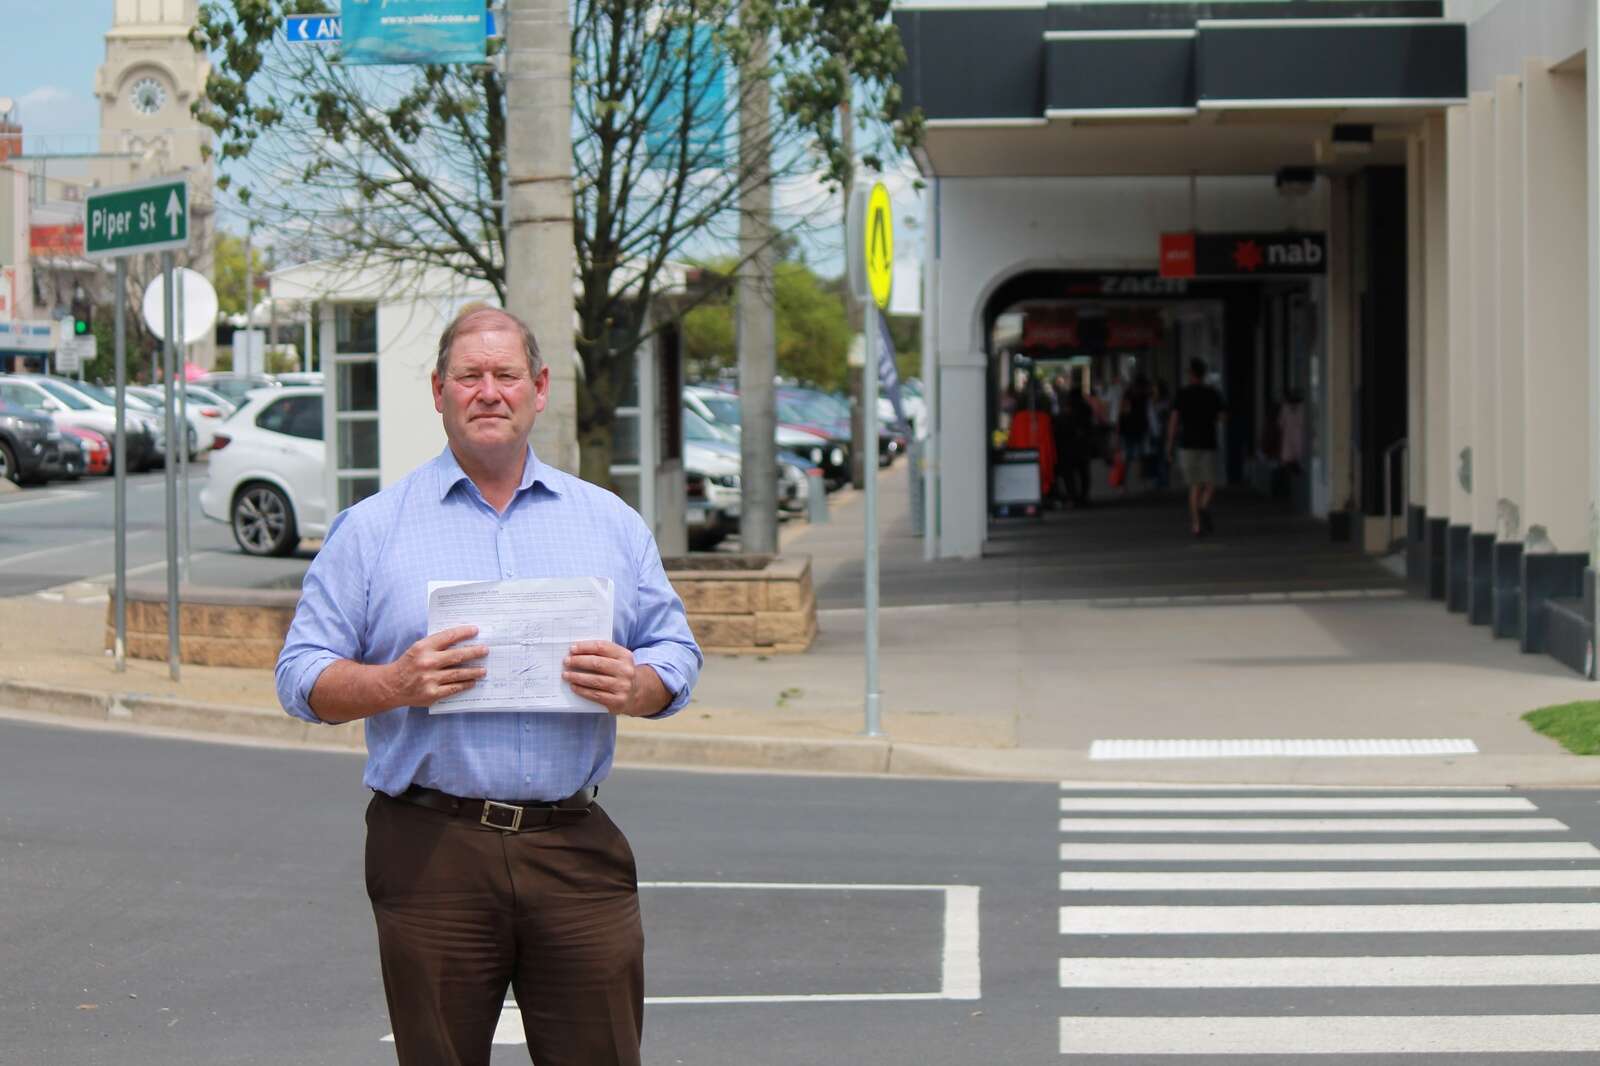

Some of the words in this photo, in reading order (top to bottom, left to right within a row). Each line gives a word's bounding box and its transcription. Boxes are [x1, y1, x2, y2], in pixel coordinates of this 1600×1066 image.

[92, 207, 132, 242] Piper
[139, 201, 156, 230] St
[1268, 238, 1322, 265] nab
